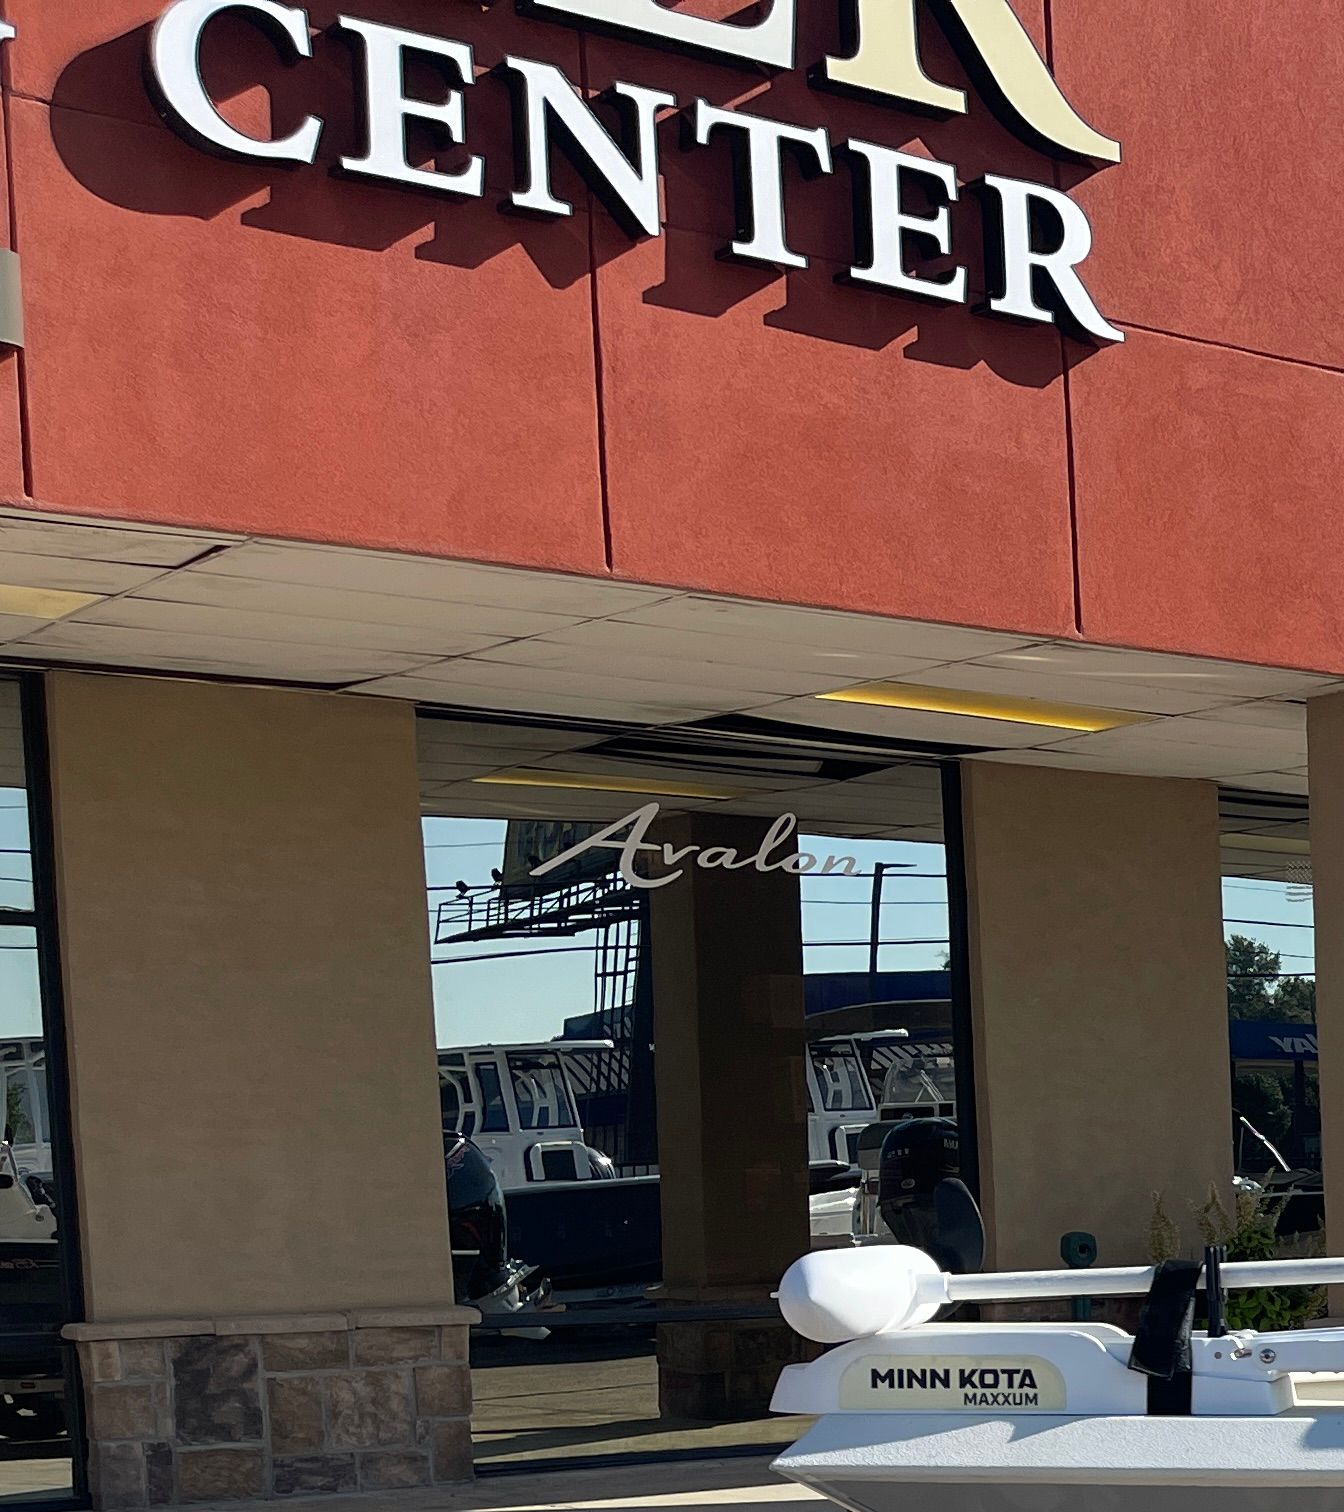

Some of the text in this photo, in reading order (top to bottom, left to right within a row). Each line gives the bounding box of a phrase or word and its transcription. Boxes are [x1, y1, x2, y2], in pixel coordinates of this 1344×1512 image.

[150, 0, 1125, 344] CENTER
[529, 802, 862, 888] Avalon
[870, 1368, 1038, 1389] MINN KOTA
[964, 1392, 1039, 1406] MAXXUM
